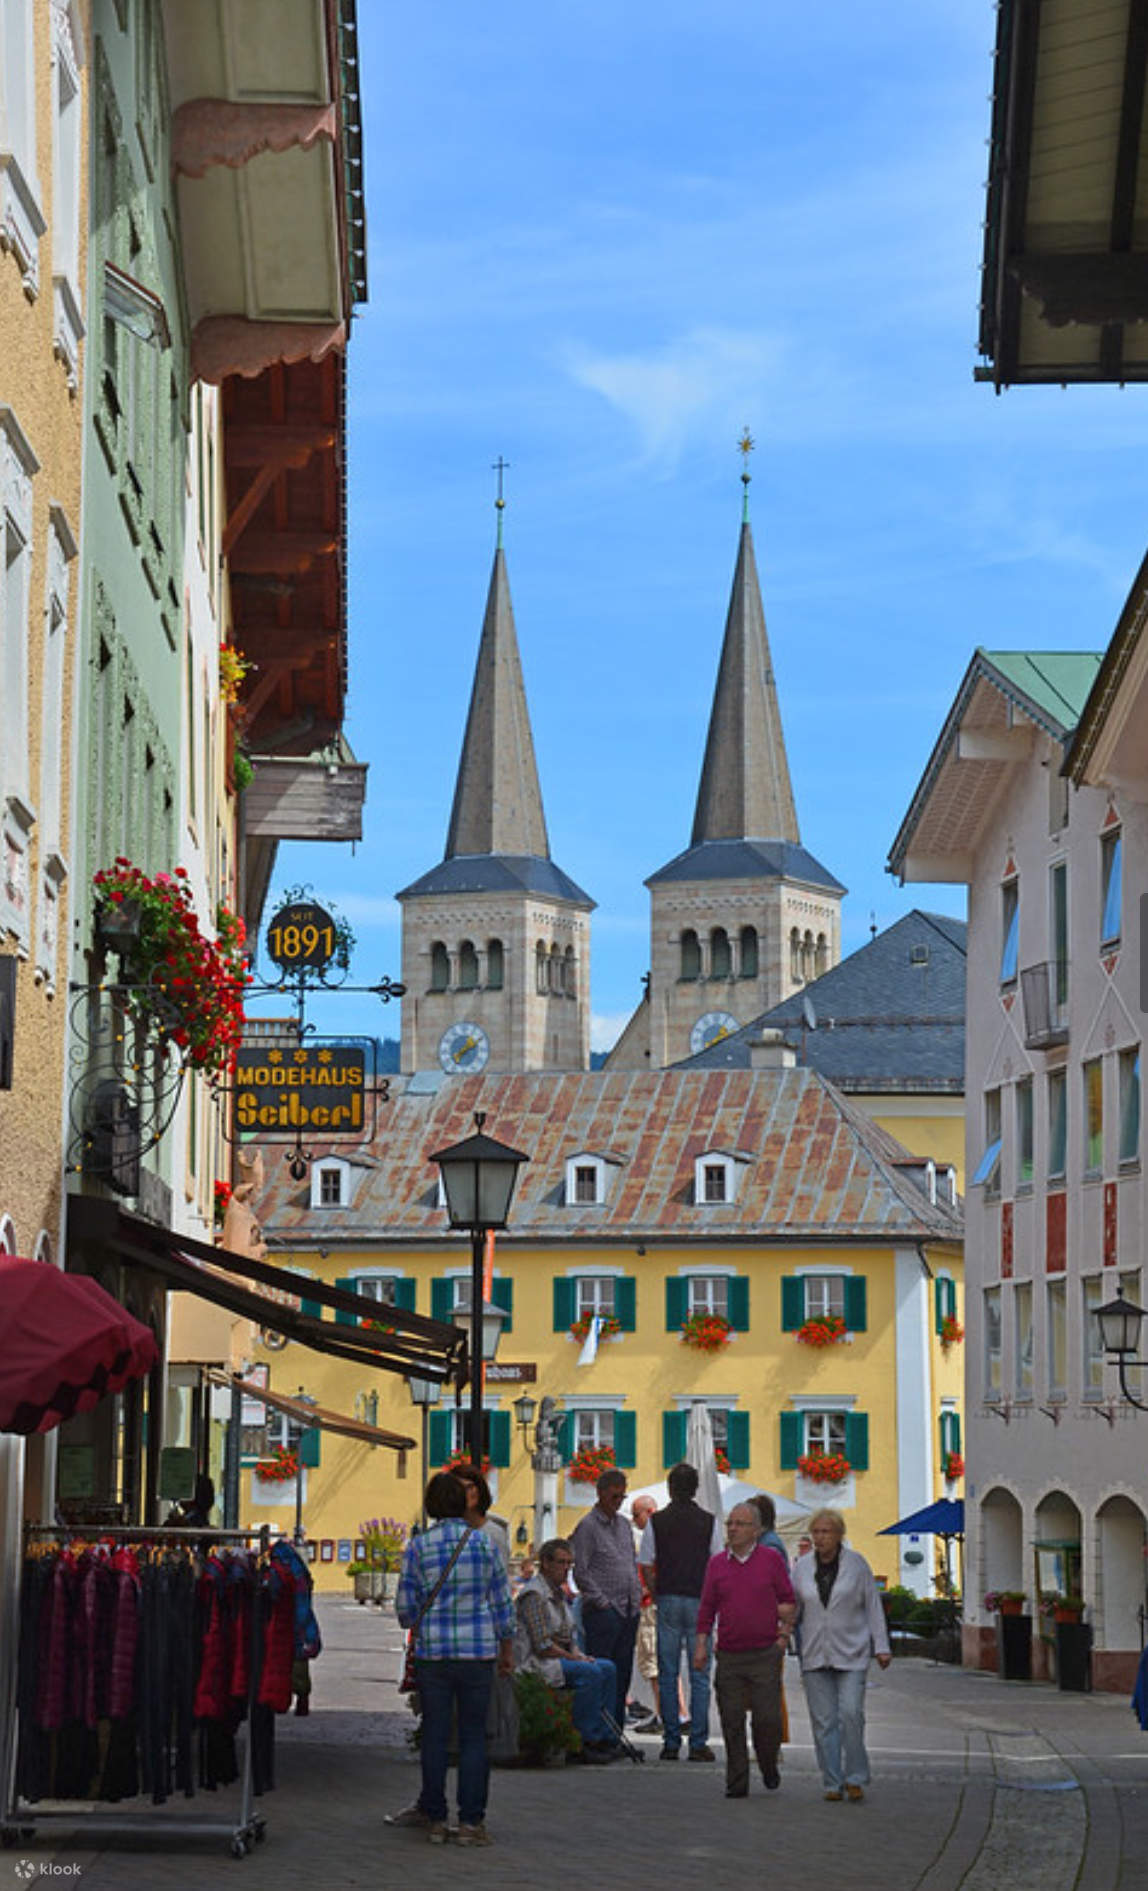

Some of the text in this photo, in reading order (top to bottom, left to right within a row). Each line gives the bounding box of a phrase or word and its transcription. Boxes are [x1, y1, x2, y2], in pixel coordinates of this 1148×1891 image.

[270, 924, 333, 958] 1891
[237, 1066, 362, 1086] MODEHAUS
[237, 1092, 361, 1127] Seiberl
